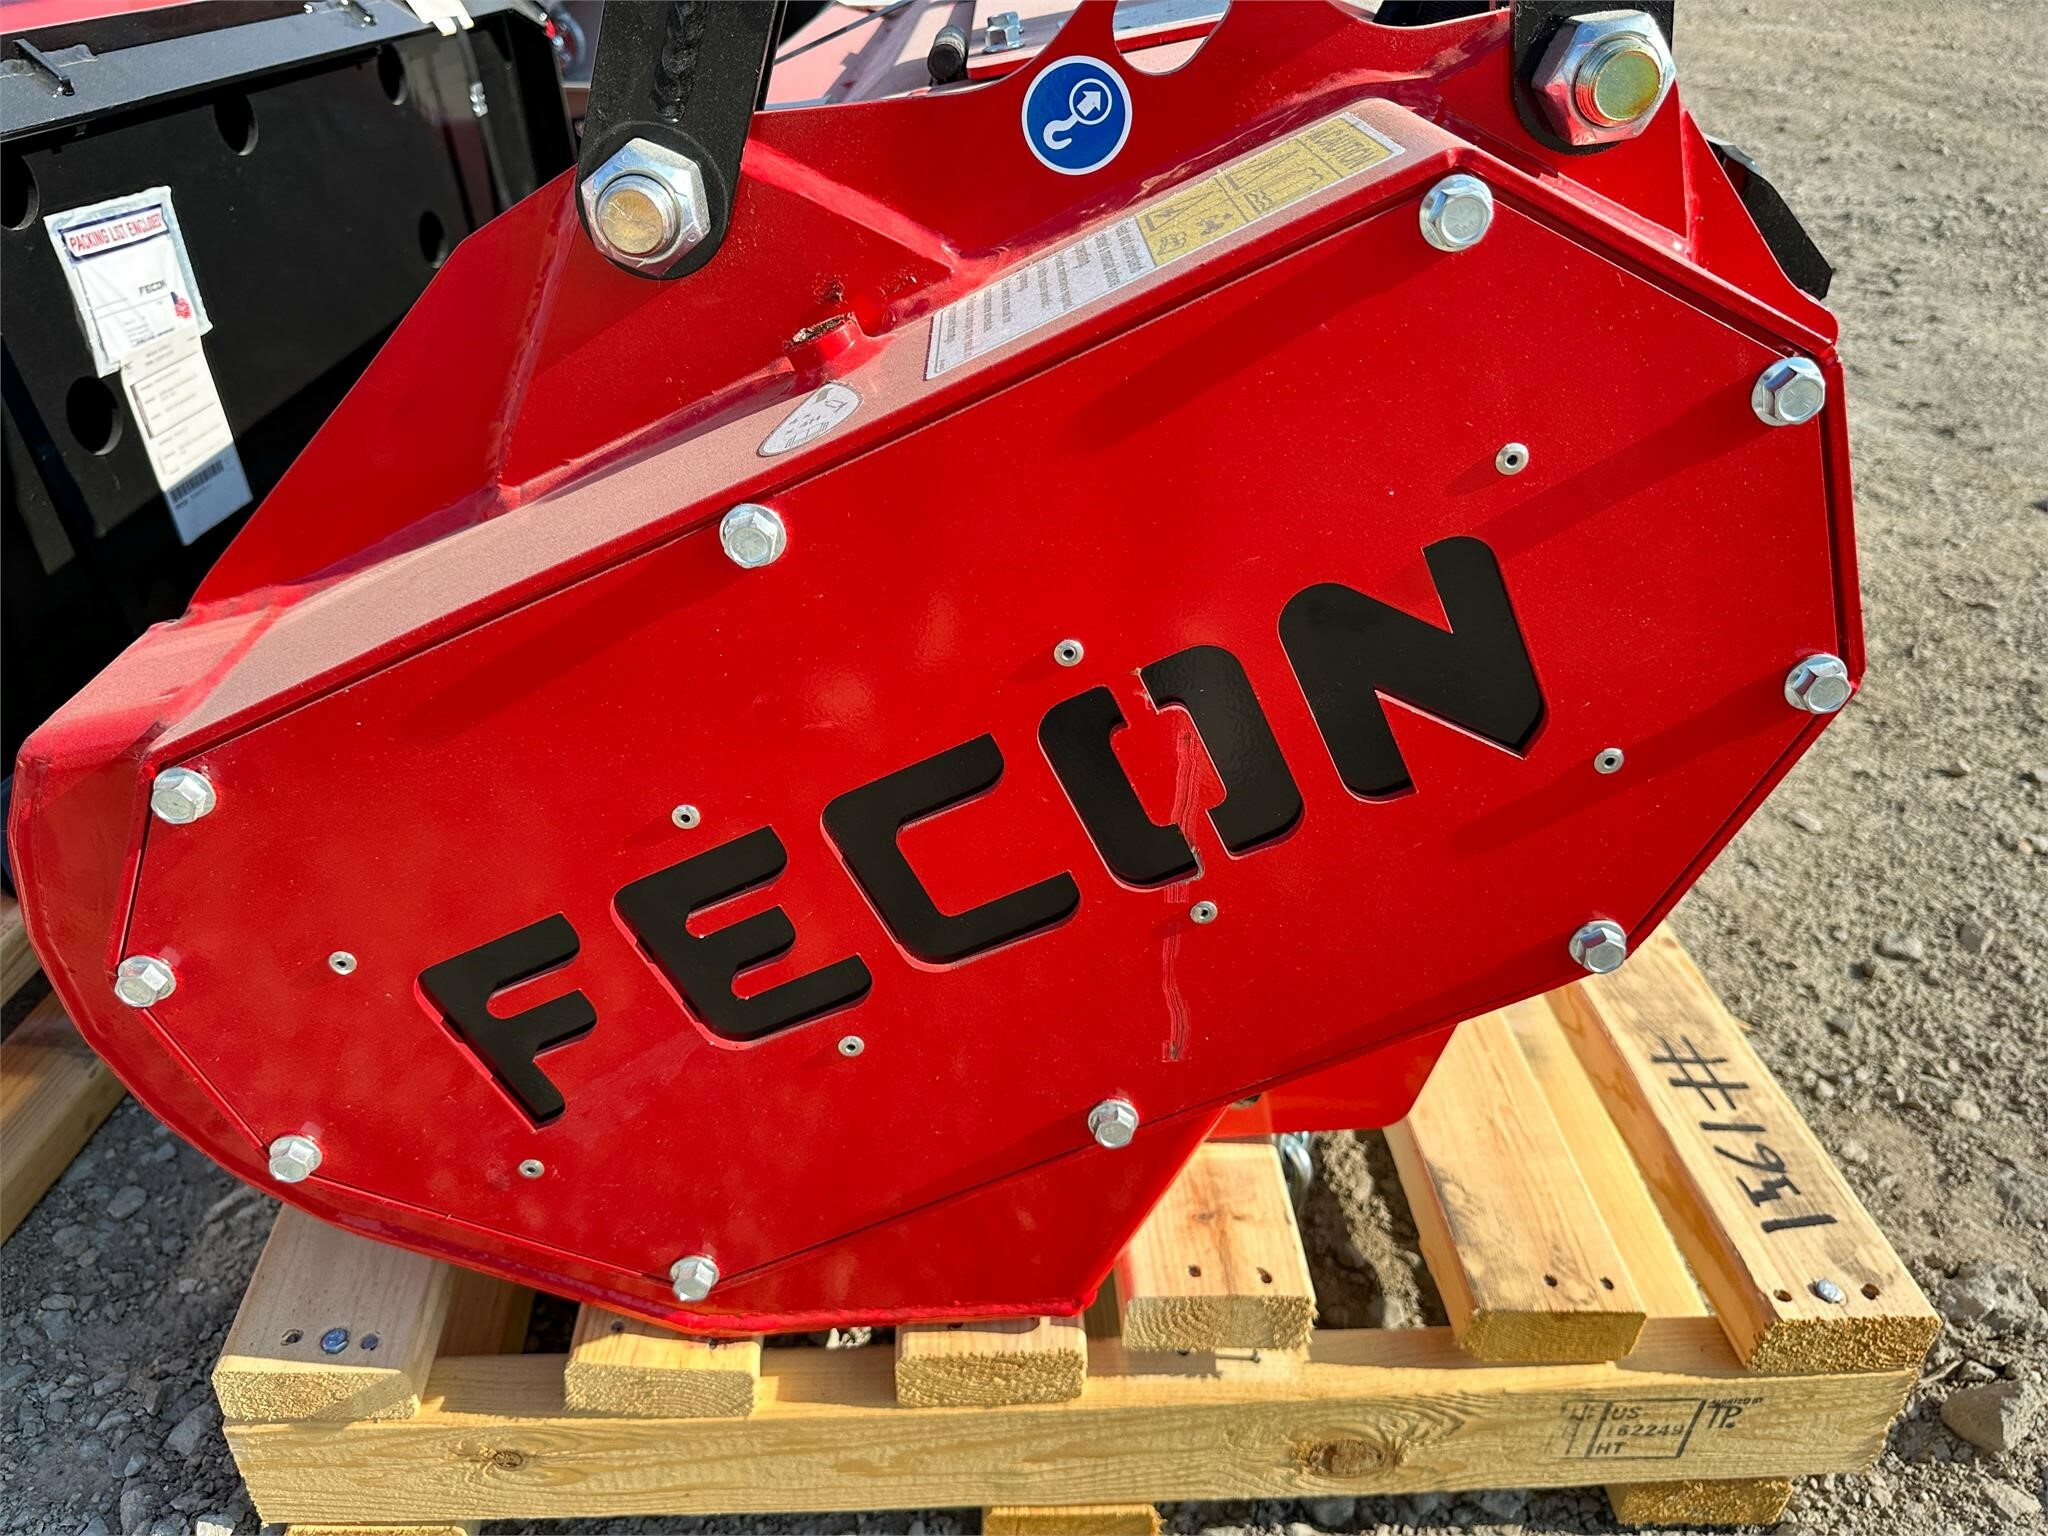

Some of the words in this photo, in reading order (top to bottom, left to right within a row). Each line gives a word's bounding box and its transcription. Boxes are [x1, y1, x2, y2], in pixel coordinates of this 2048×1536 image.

[1314, 128, 1374, 169] CAUTION
[69, 228, 109, 251] PACKING
[109, 224, 127, 241] LIST
[127, 213, 162, 236] ENCLOSED
[415, 535, 1547, 1127] FECON
[1611, 1406, 1642, 1421] US
[1595, 1442, 1625, 1455] HT
